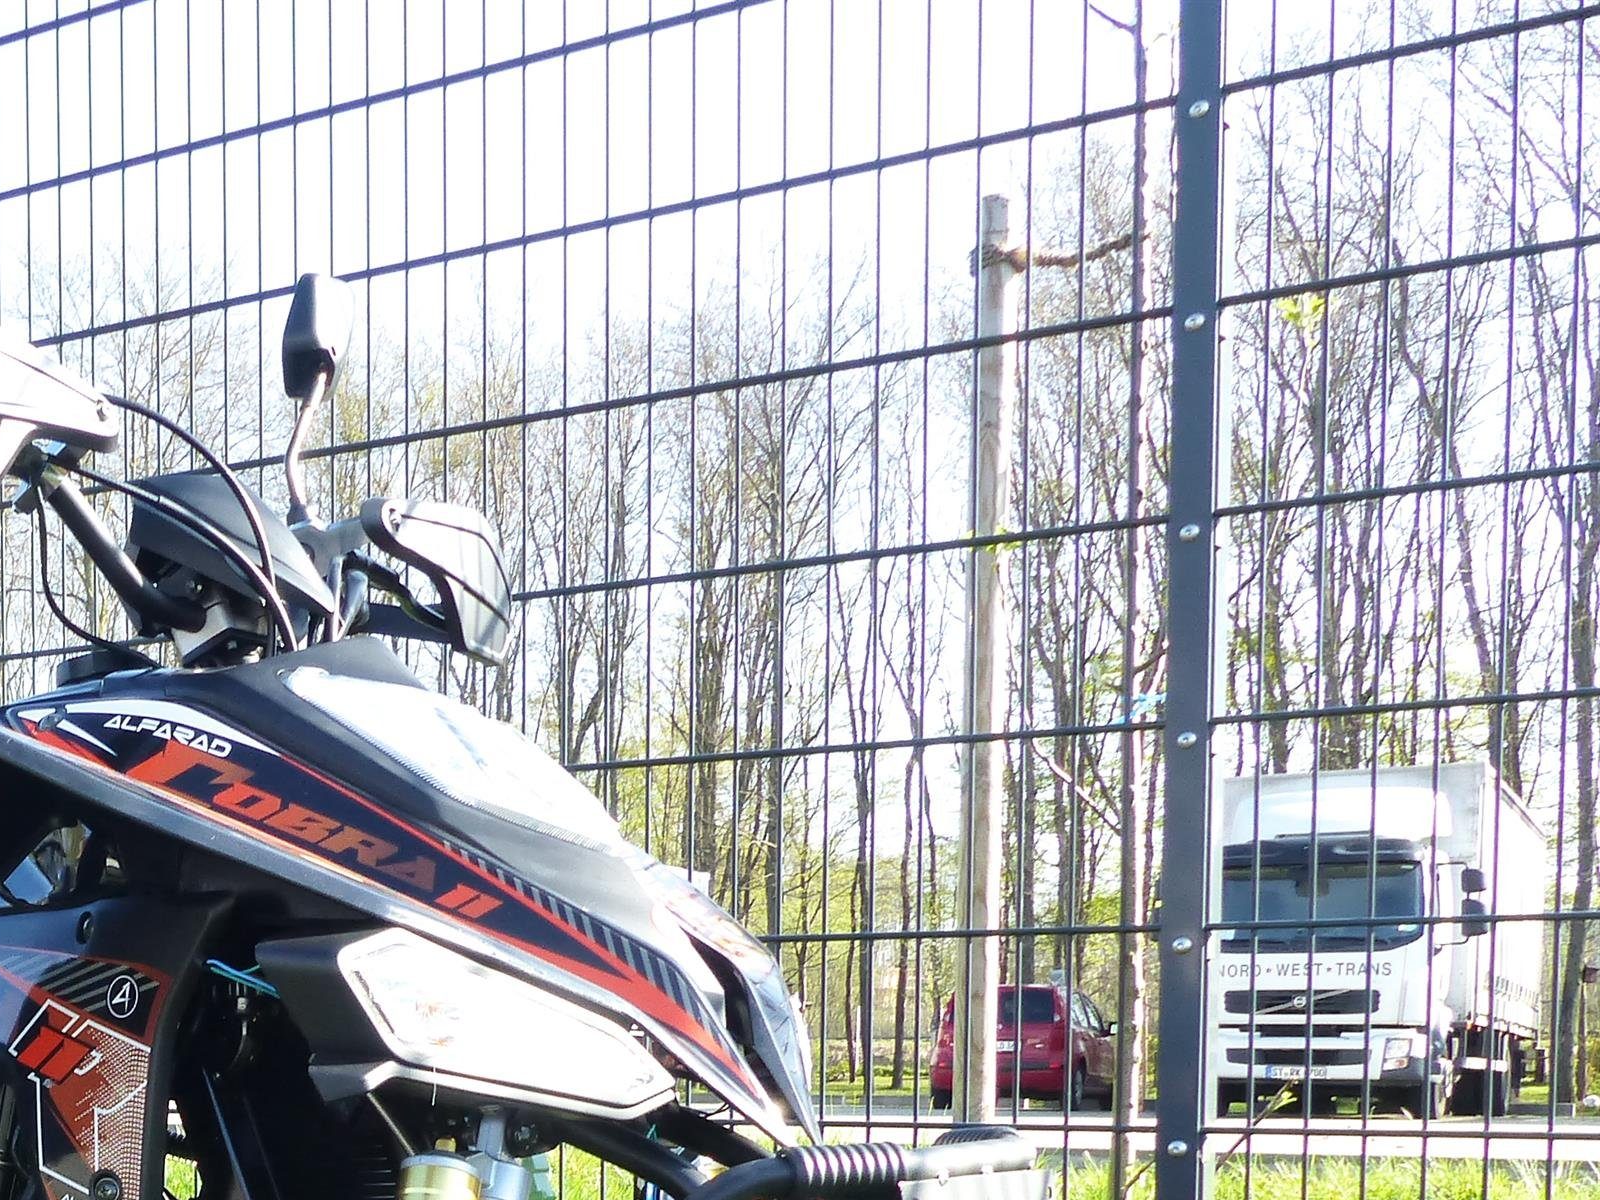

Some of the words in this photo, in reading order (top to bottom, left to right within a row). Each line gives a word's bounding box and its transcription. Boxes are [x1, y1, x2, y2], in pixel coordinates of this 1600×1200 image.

[103, 714, 232, 758] ALFARAD
[125, 739, 436, 893] COBRA
[1276, 963, 1324, 977] WEST
[1336, 962, 1392, 977] TRANS
